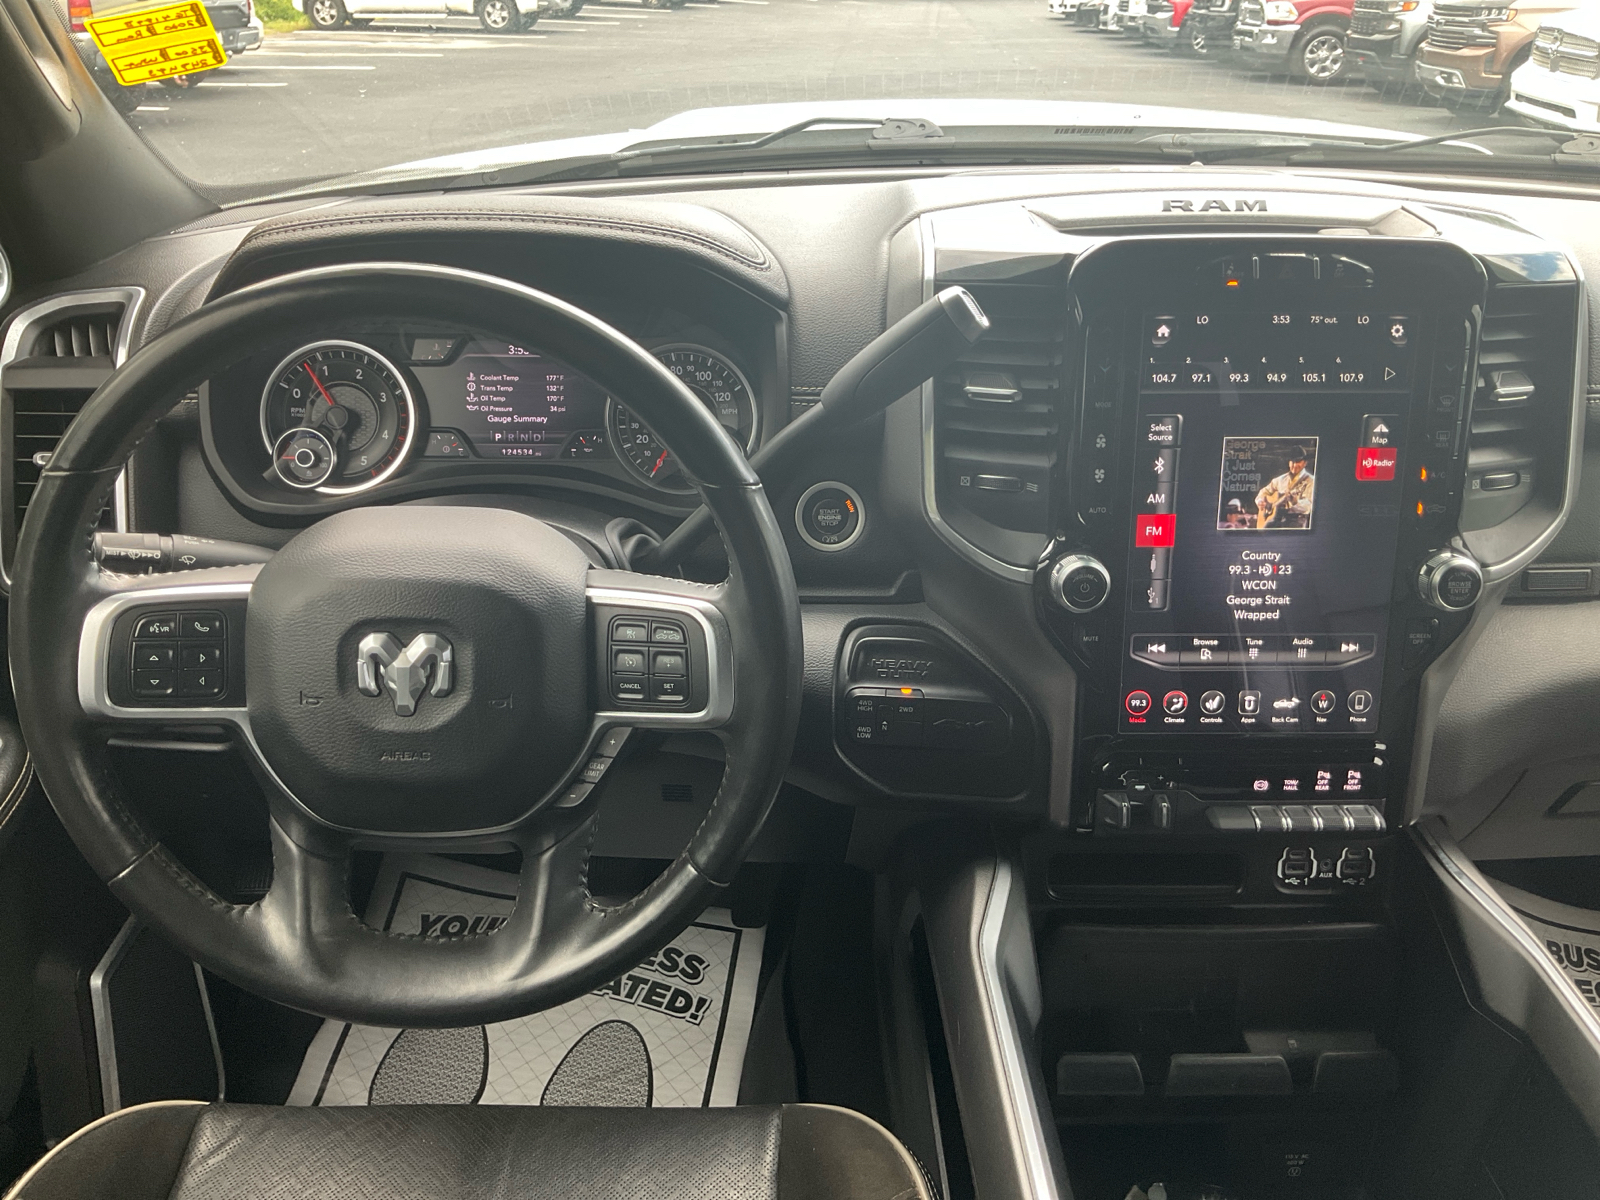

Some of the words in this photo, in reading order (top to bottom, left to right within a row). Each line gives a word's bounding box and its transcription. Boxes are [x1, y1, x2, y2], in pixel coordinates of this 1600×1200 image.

[1161, 199, 1268, 212] RAM
[1196, 315, 1209, 324] LO
[1272, 315, 1290, 324] 3:53
[1357, 315, 1370, 324] LO
[322, 365, 329, 376] 1
[355, 369, 363, 379] 2
[670, 366, 683, 376] 80
[503, 374, 519, 382] Temp
[695, 371, 712, 381] 100
[1151, 373, 1177, 383] 104.7
[1191, 373, 1211, 383] 97.1
[1229, 373, 1249, 383] 99.3
[1266, 373, 1287, 383] 94.9
[1302, 373, 1326, 383] 105.1
[1339, 373, 1364, 383] 107.9
[292, 388, 301, 398] 0
[380, 392, 387, 402] 3
[714, 392, 731, 401] 120
[487, 415, 512, 423] Gauge
[513, 415, 548, 424] Summary
[382, 430, 389, 440] 4
[495, 433, 502, 441] P
[636, 434, 649, 443] 20
[1148, 433, 1173, 441] Source
[1225, 440, 1266, 451] George
[1371, 436, 1388, 445] Map
[502, 448, 533, 456] 124534
[1224, 450, 1252, 460] Strait
[360, 455, 368, 466] 5
[1232, 460, 1256, 471] Just
[1222, 470, 1262, 481] Comes
[1221, 480, 1260, 492] Natural
[1147, 493, 1165, 503] AM
[1145, 526, 1162, 536] FM
[1241, 550, 1281, 562] Country
[1228, 565, 1250, 575] 99.3
[1241, 580, 1276, 590] WCON
[1226, 595, 1262, 606] George
[1265, 595, 1291, 605] Strait
[1233, 609, 1280, 621] Wrapped
[1193, 638, 1219, 646] Browse
[1246, 638, 1263, 646] Tune
[1292, 638, 1314, 646] Audio
[871, 658, 933, 669] HEAVY
[877, 668, 928, 678] DUTY
[380, 751, 431, 761] AIRBAG
[419, 913, 509, 936] YOU
